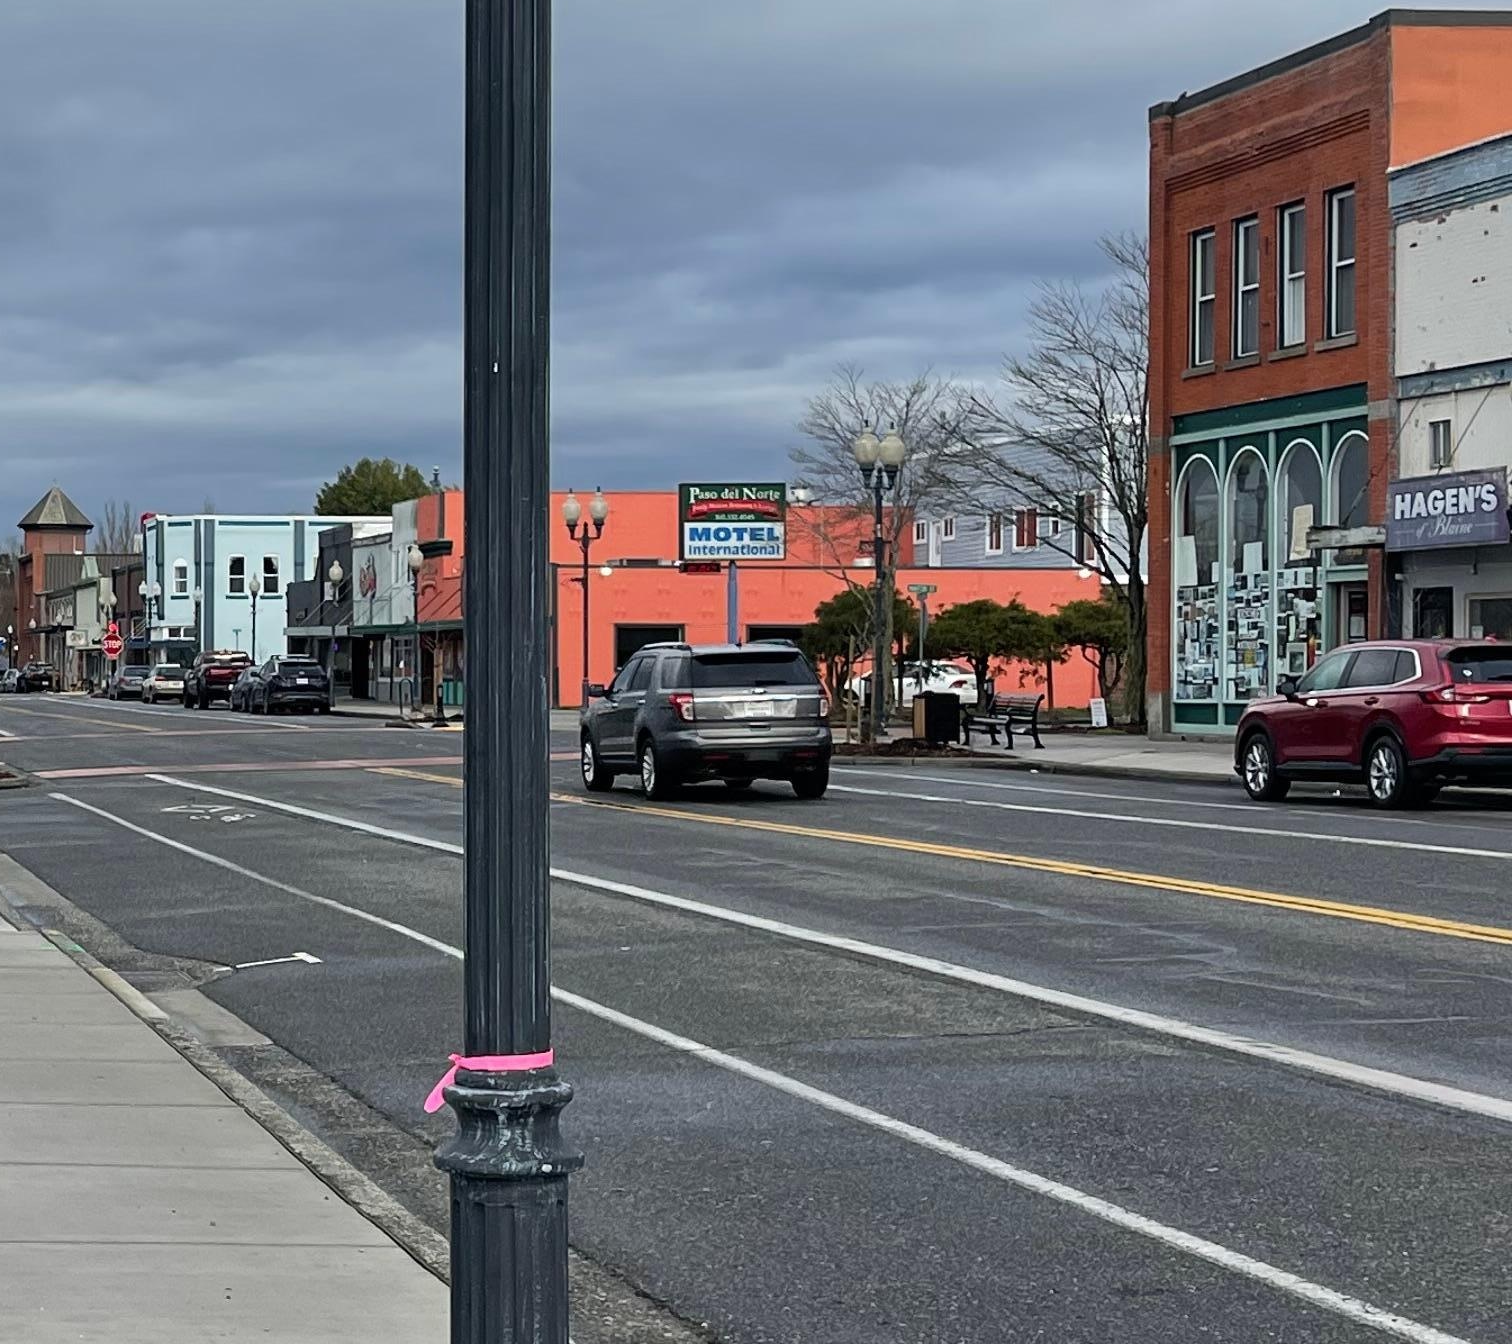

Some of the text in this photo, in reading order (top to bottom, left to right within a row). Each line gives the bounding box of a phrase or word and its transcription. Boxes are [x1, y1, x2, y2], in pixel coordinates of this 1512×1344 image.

[689, 487, 780, 504] Paso del Norte
[1394, 484, 1498, 520] HAGEN'S
[689, 527, 780, 542] MOTEL
[689, 544, 780, 555] International
[104, 640, 122, 649] STOP
